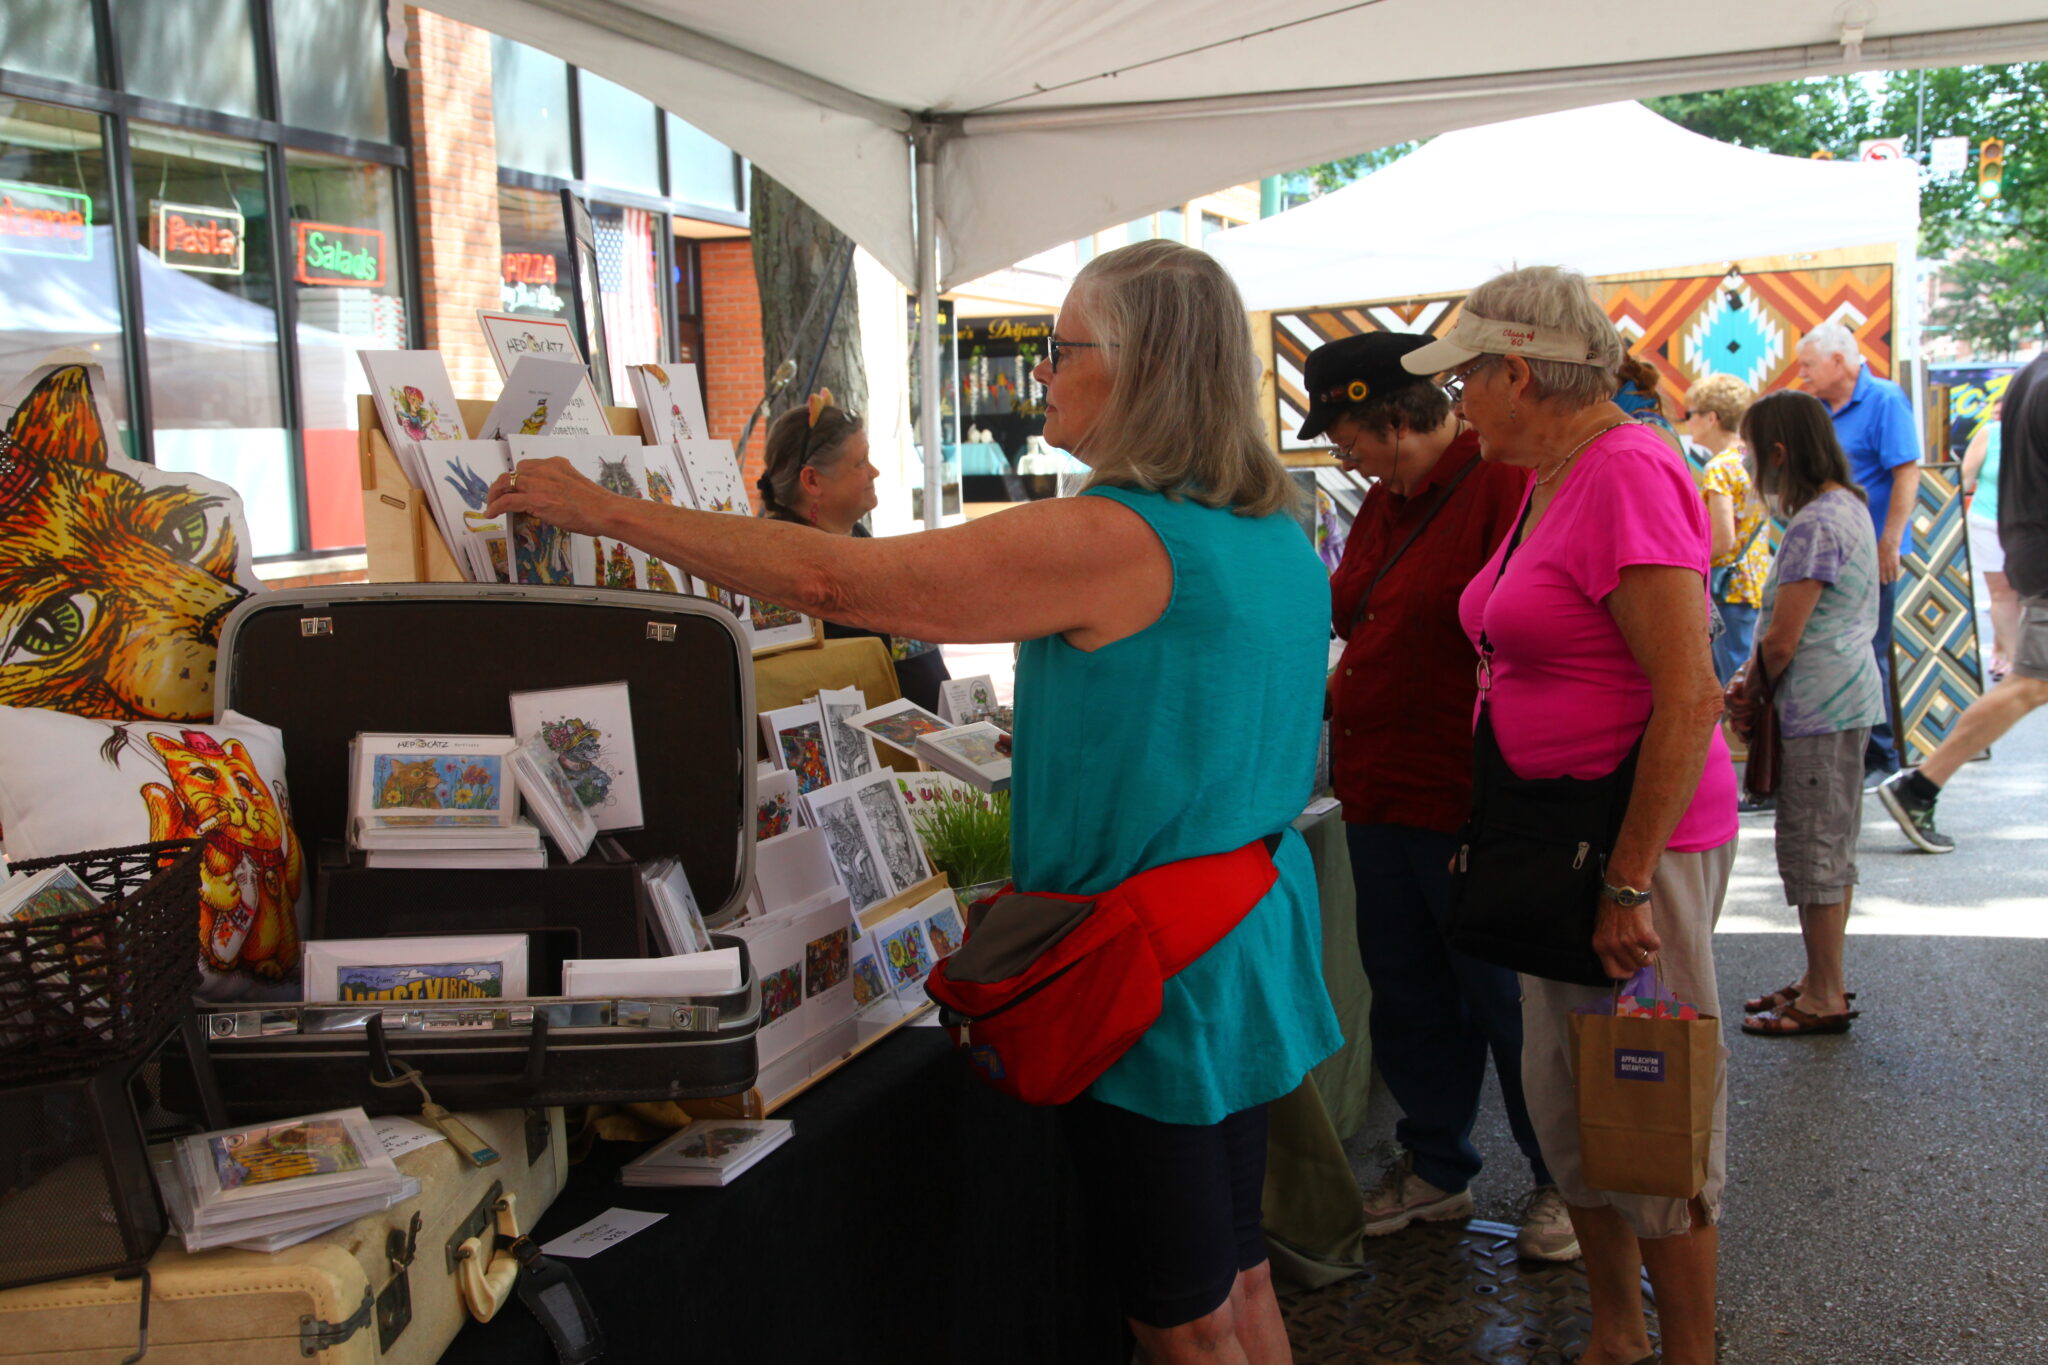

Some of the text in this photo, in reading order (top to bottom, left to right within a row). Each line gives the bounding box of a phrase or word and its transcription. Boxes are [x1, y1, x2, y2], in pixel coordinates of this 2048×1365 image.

[166, 215, 235, 255] Pasta
[307, 232, 377, 281] Salads
[503, 252, 557, 284] PIZZA
[1503, 329, 1535, 342] Class of
[552, 426, 590, 437] something
[427, 740, 449, 748] CATZ
